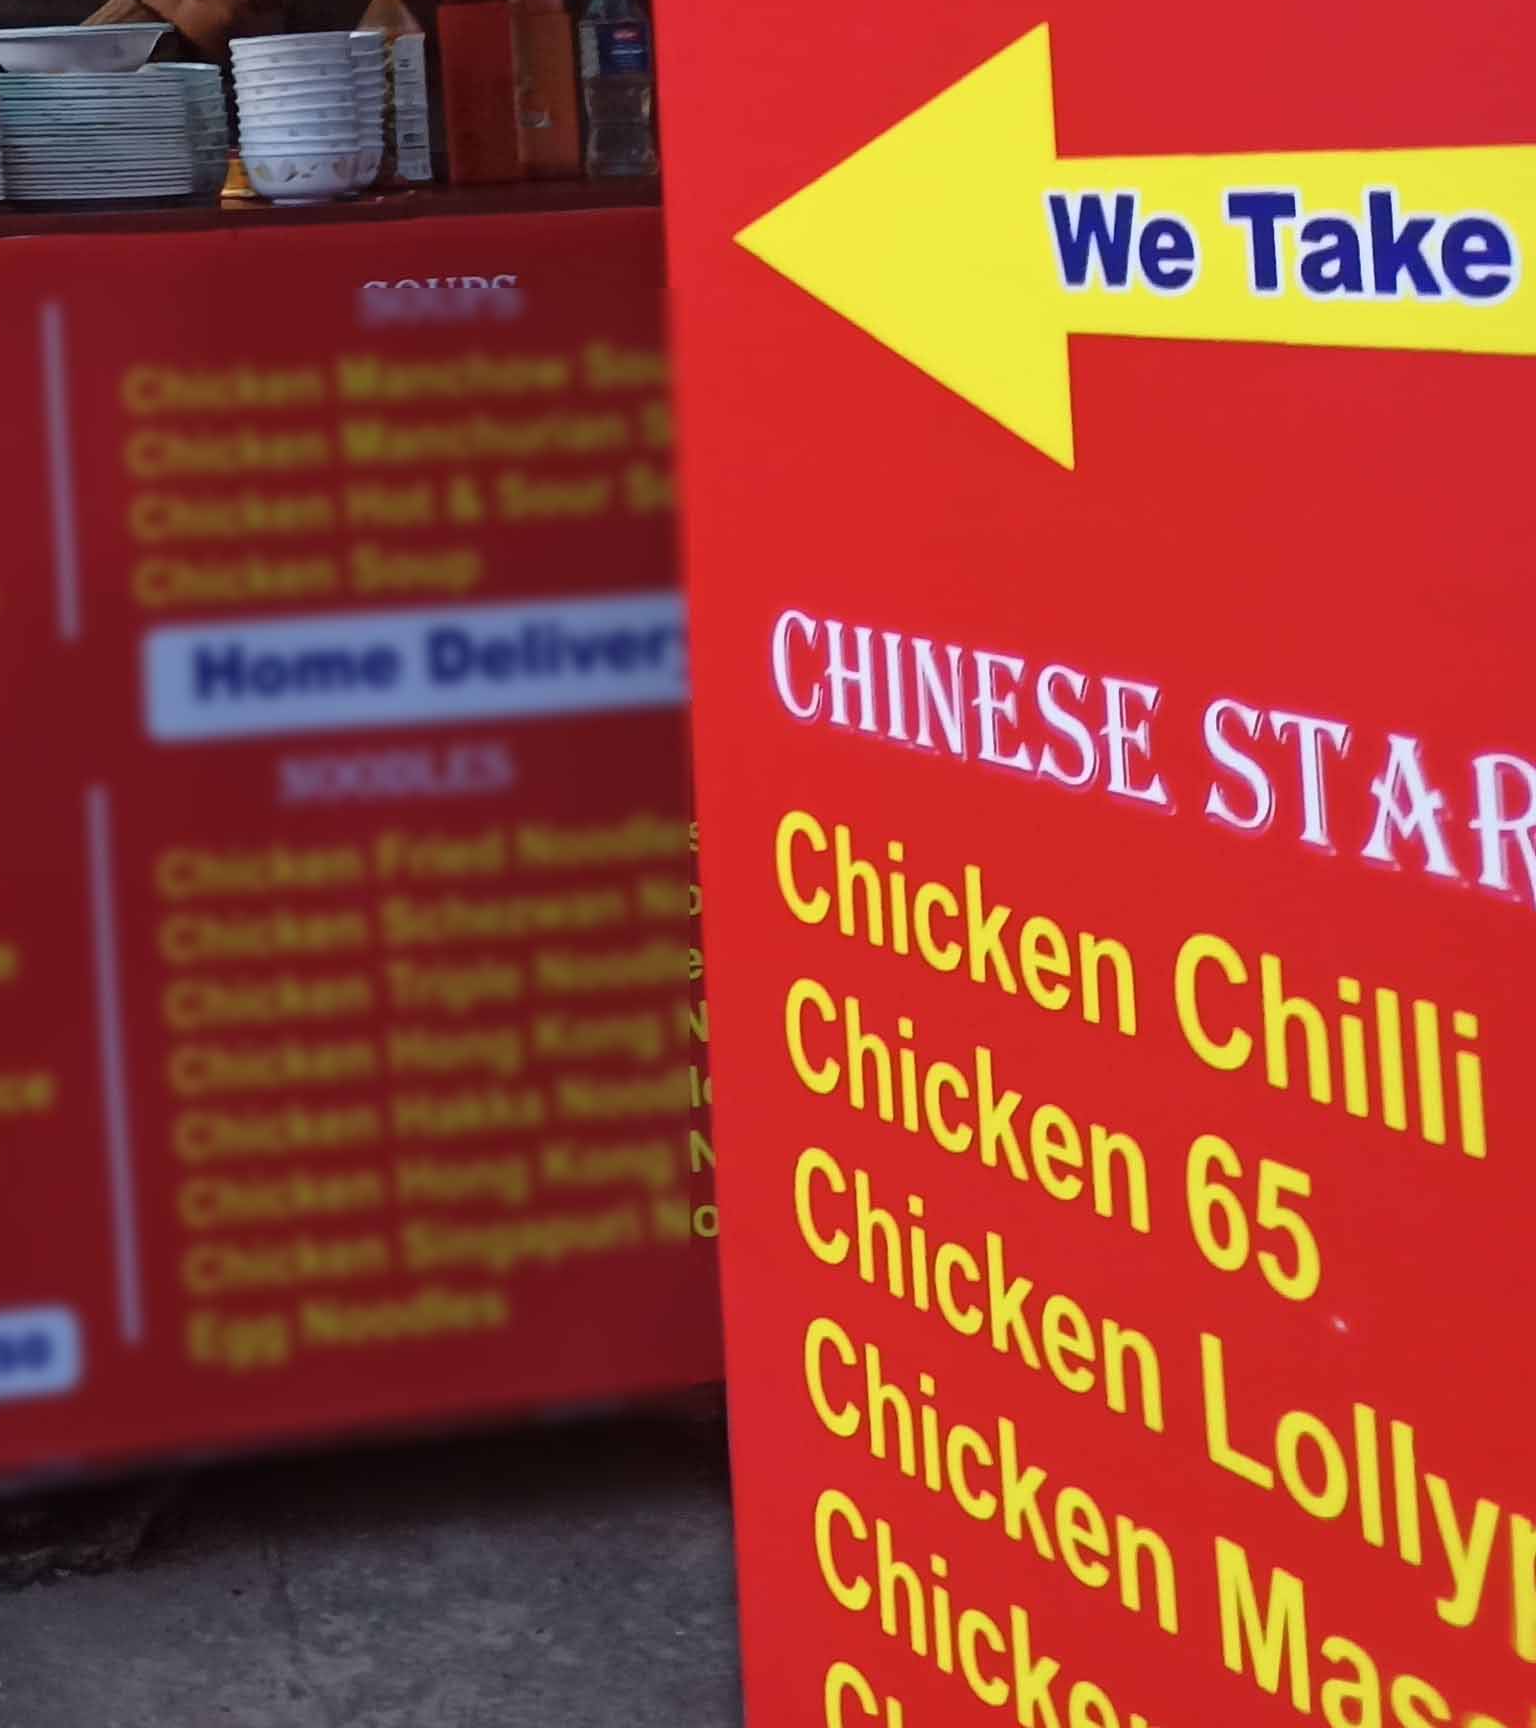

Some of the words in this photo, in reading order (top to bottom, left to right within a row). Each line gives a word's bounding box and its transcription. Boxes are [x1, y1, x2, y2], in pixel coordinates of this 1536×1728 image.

[1048, 193, 1196, 290] We
[1228, 190, 1514, 300] Take
[771, 608, 1173, 813] CHINESE
[775, 810, 1136, 1036] Chicken
[1175, 932, 1488, 1160] Chilli
[785, 978, 1150, 1233] Chicken
[1186, 1133, 1321, 1302] 65
[794, 1147, 1164, 1433] Chicken
[803, 1316, 1179, 1636] Chicken
[814, 1488, 1147, 1728] Chick
